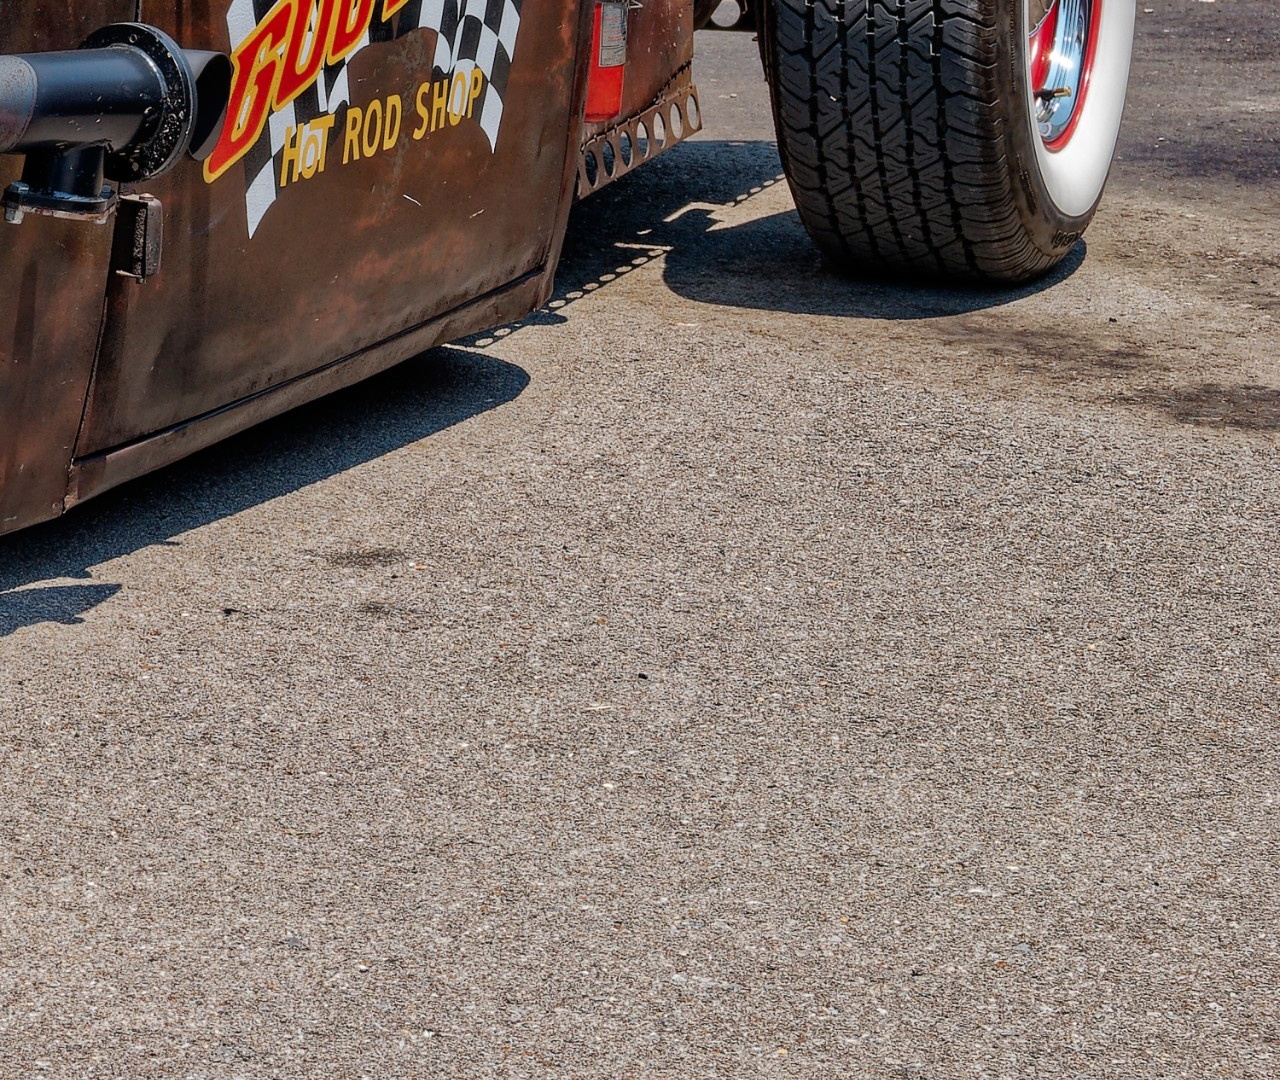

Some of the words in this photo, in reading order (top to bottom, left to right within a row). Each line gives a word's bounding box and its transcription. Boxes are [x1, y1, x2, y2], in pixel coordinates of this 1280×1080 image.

[280, 114, 335, 187] HOT
[342, 94, 402, 165] ROD
[412, 68, 484, 142] SHOP
